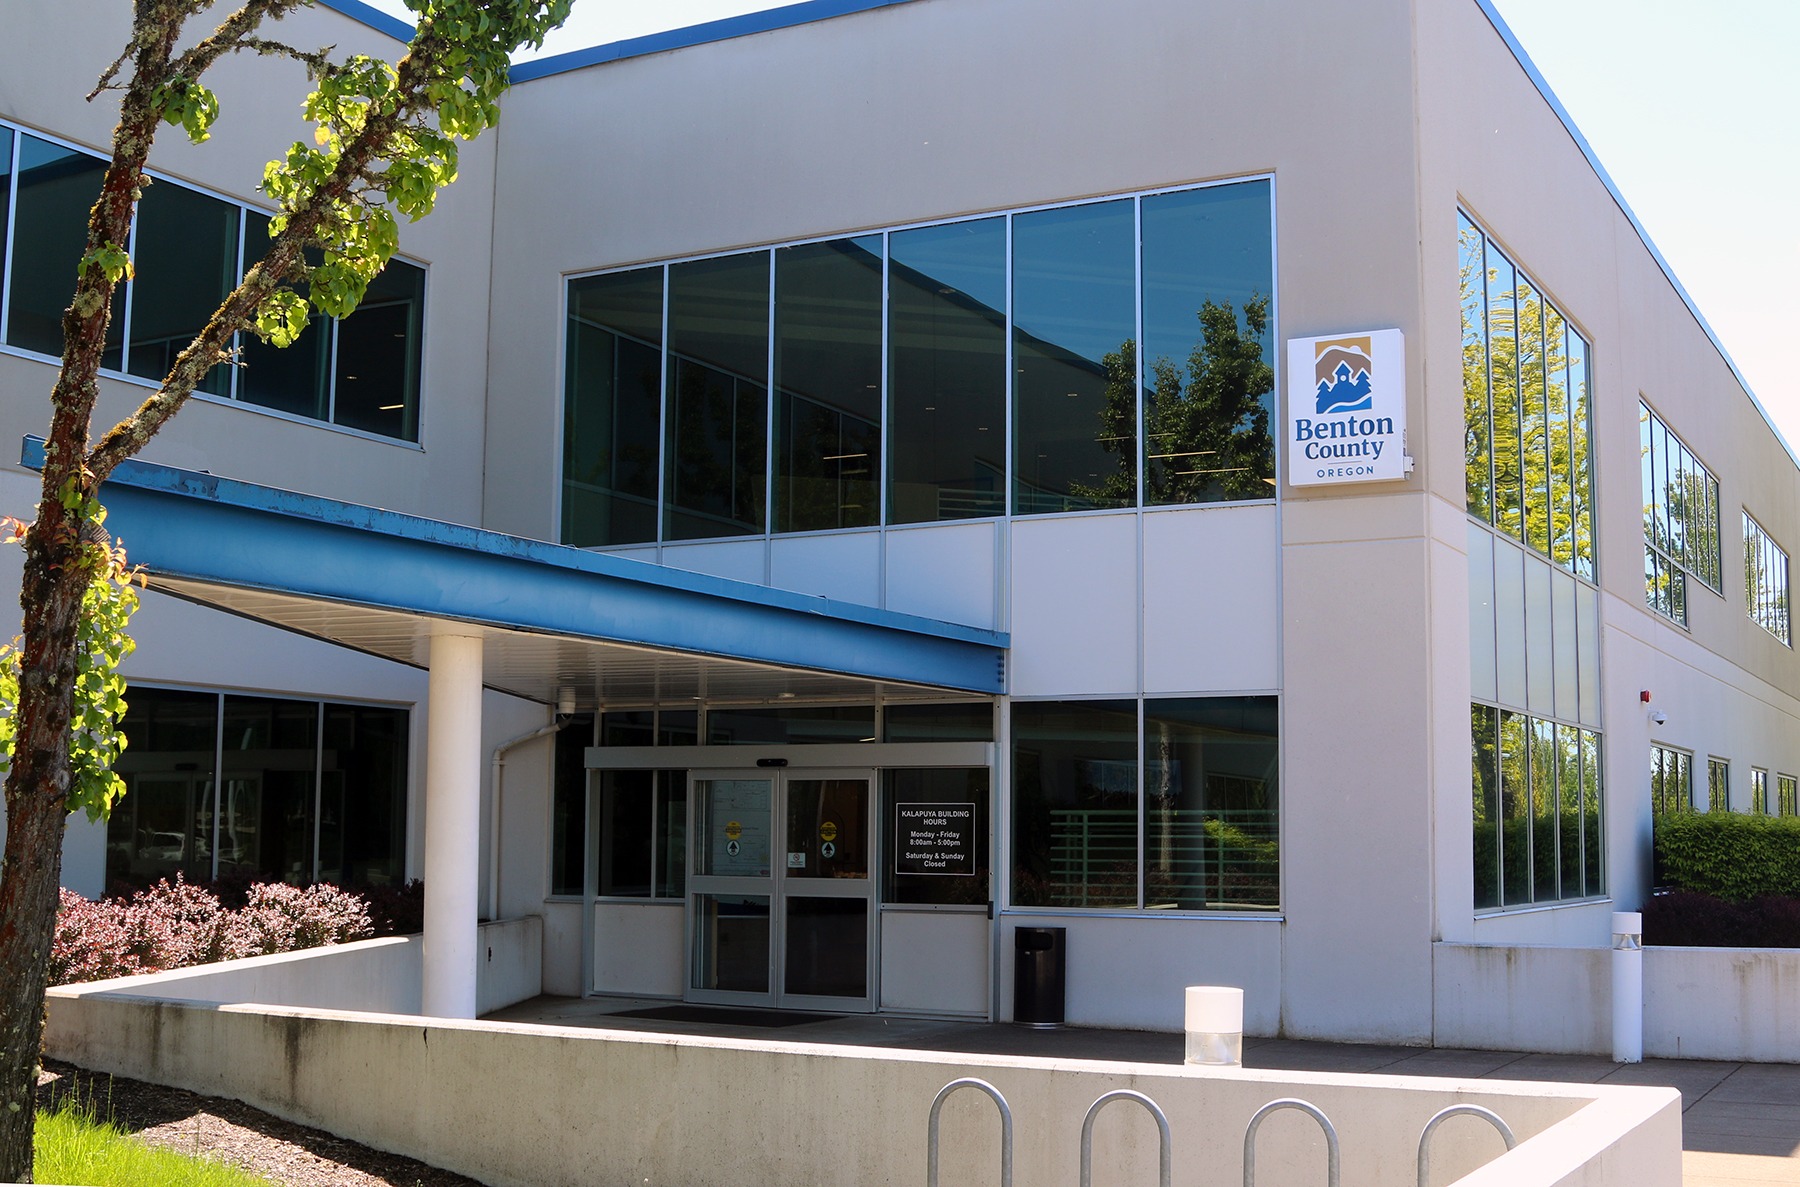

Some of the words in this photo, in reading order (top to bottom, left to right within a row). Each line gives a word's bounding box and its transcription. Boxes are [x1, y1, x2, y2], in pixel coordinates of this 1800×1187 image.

[1295, 416, 1394, 441] Benton
[1305, 439, 1384, 460] County
[1317, 466, 1374, 478] OREGON
[910, 831, 935, 839] Monday
[940, 831, 960, 839] Friday
[937, 839, 961, 847] 5:00pm
[905, 852, 933, 860] Saturday
[940, 853, 965, 861] Sunday
